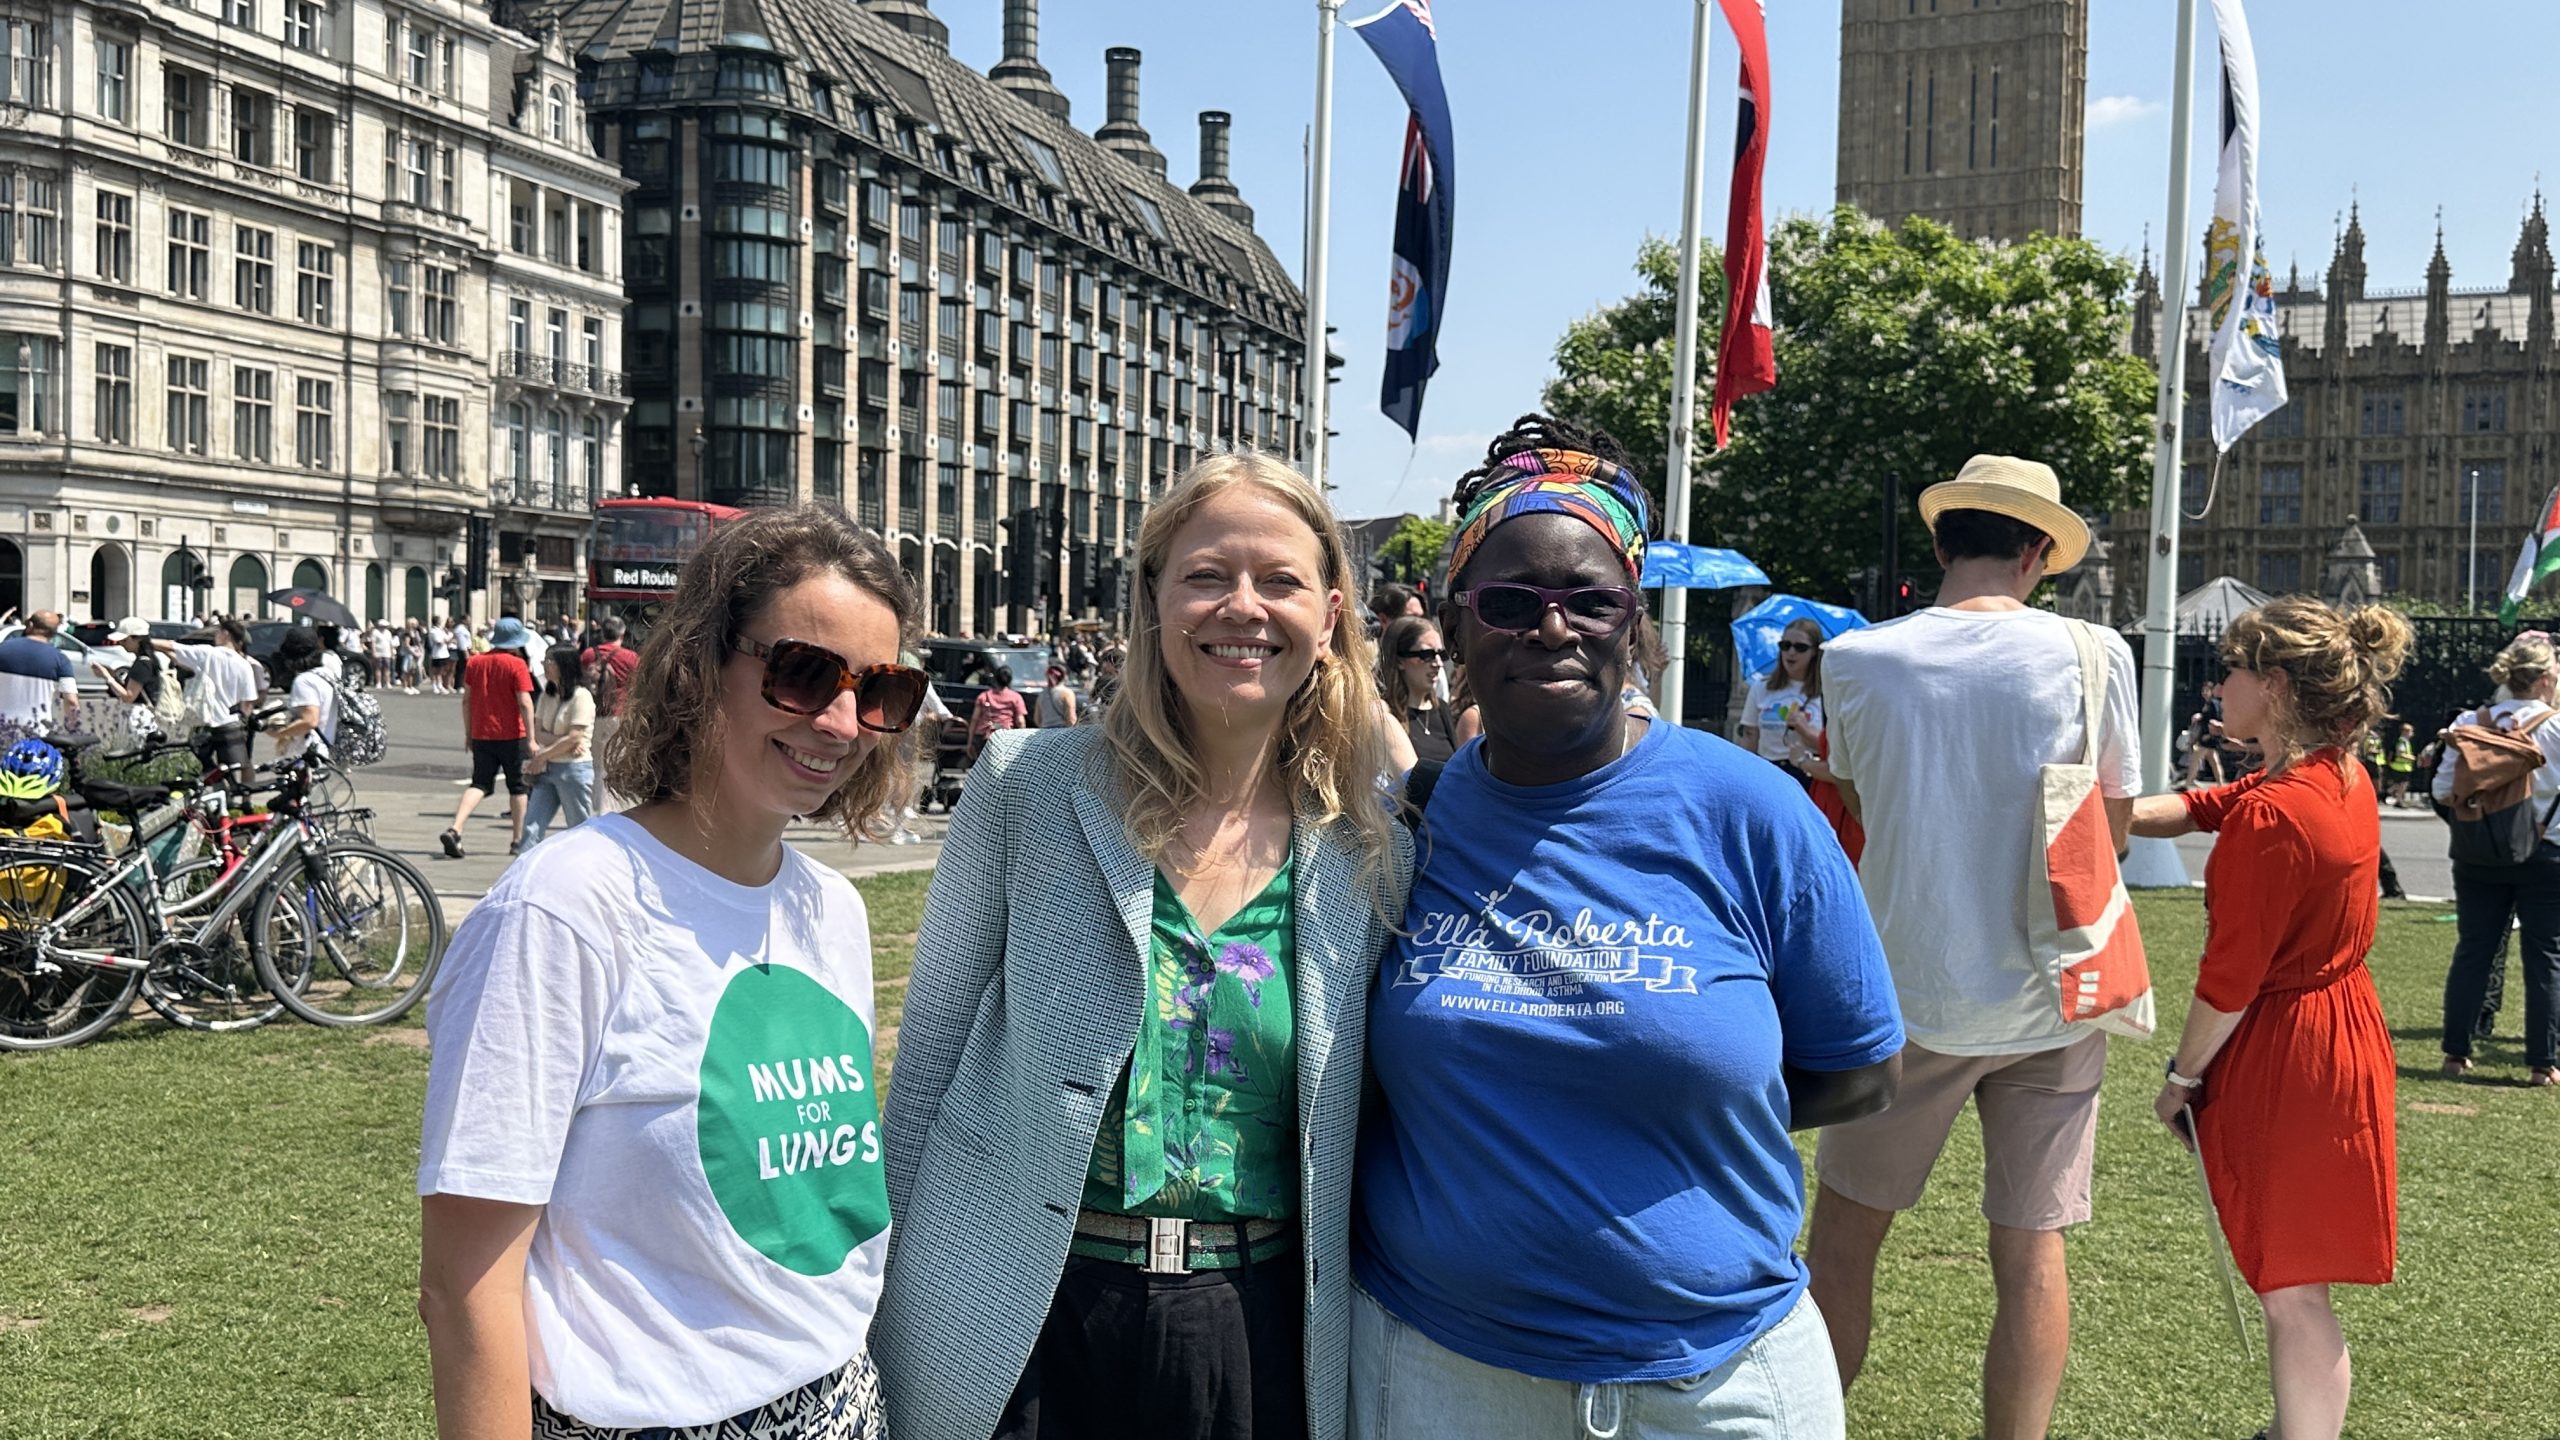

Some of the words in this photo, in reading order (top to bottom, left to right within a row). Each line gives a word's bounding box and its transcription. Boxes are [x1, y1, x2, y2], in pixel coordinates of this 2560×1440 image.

[613, 568, 639, 585] Red
[640, 569, 678, 586] Route
[1412, 912, 1495, 949] Ella
[1505, 907, 1693, 949] Roberta
[1455, 951, 1518, 972] FAMILY
[1523, 951, 1622, 973] FOUNDATION
[1463, 972, 1500, 984] FUNDING
[1502, 975, 1545, 987] RESEARCH
[1547, 975, 1563, 986] AND
[1564, 972, 1609, 984] EDUCATION
[1481, 983, 1492, 992] IN
[1493, 983, 1544, 997] CHILDHOOD
[1546, 984, 1584, 997] ASTHMA
[1441, 995, 1625, 1017] WWW.ELLAROBERTA.ORG
[748, 1055, 865, 1102] MUMS
[797, 1100, 832, 1125] FOR
[758, 1120, 880, 1180] LUNGS
